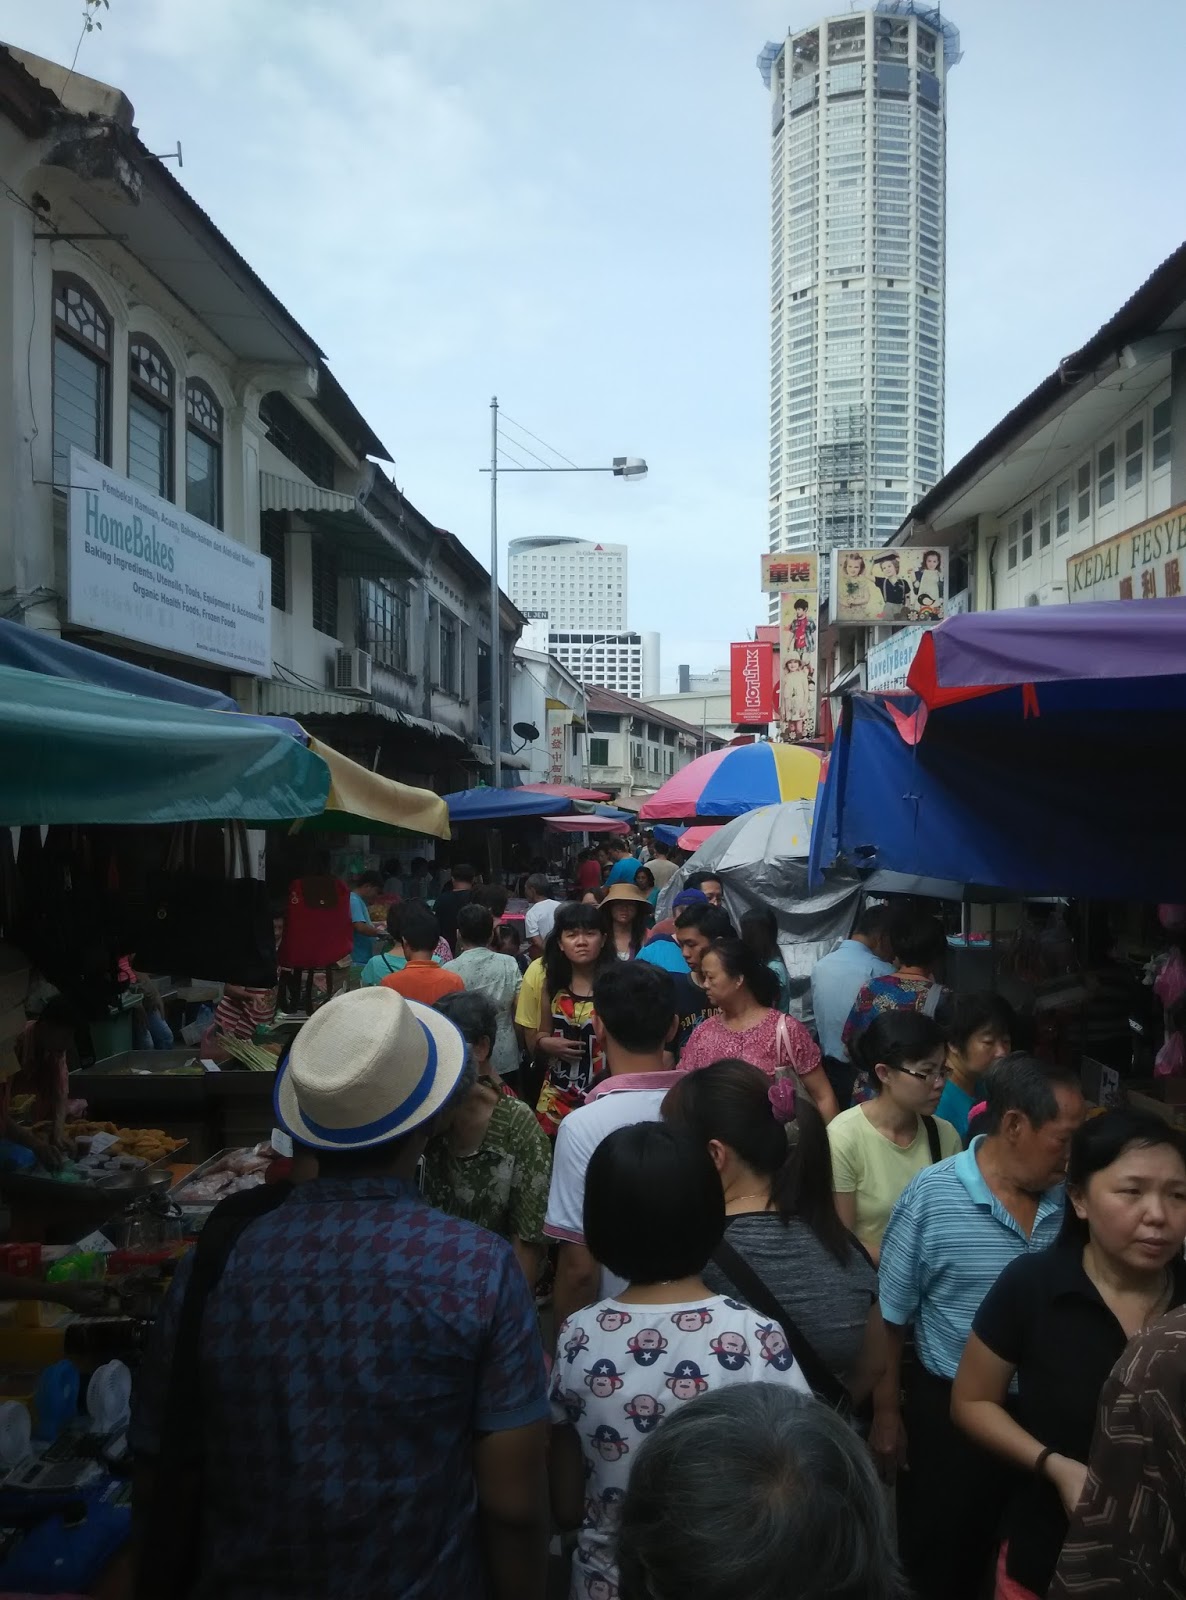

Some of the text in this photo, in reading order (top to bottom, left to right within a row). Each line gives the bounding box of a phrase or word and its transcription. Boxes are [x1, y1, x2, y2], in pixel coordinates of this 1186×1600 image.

[85, 490, 174, 573] HomeBakes
[85, 540, 112, 565] Baking
[113, 553, 155, 582] Ingredients,
[156, 572, 183, 594] Utensils,
[203, 591, 231, 611] Equipment
[232, 603, 236, 613] &
[237, 605, 265, 624] Accessories
[769, 563, 811, 583] 童裝
[1073, 544, 1121, 592] KEDAI
[132, 581, 159, 601] Organic
[160, 592, 181, 609] Health
[202, 608, 220, 623] Frozen
[221, 615, 236, 629] Foods
